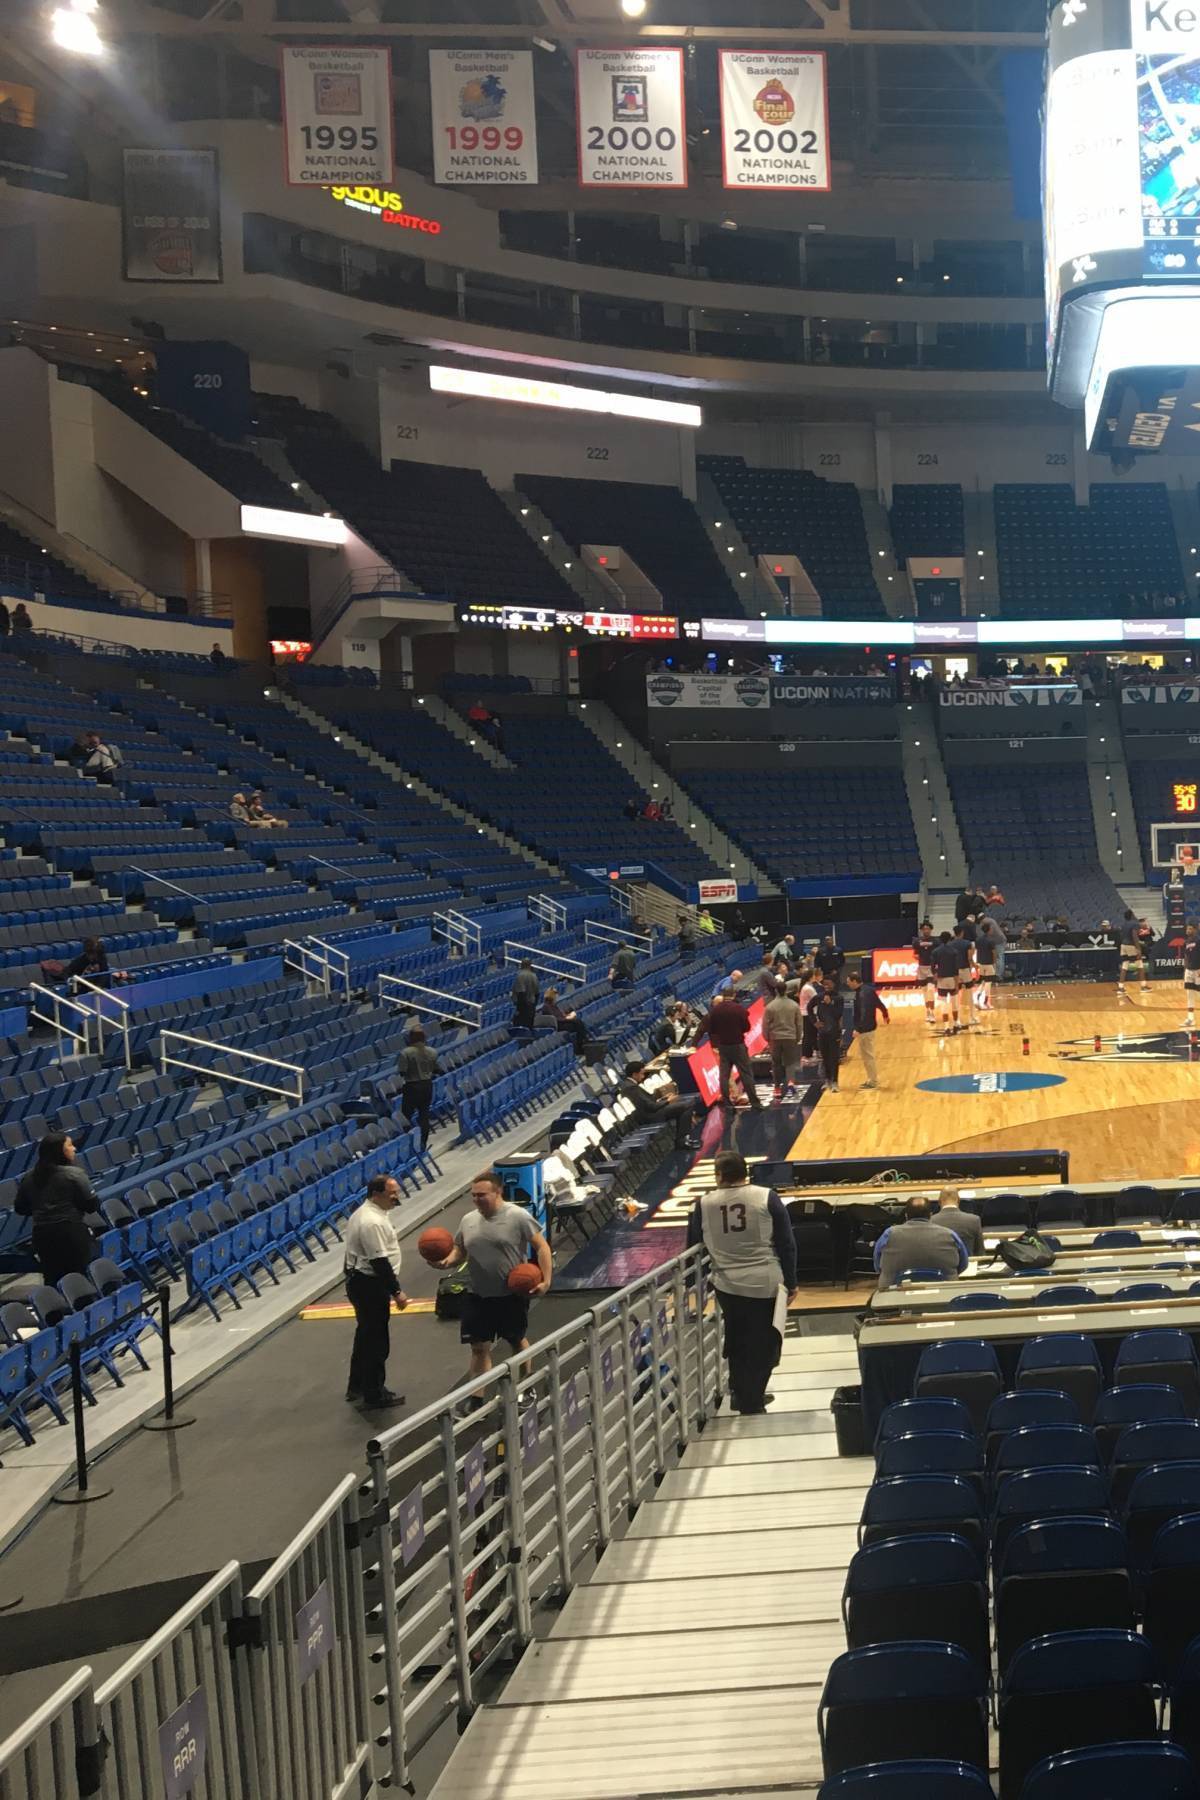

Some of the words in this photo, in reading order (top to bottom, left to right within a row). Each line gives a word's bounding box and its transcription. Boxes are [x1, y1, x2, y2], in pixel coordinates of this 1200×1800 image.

[731, 54, 765, 63] UConn
[768, 55, 814, 64] Women's
[454, 63, 509, 72] Basketball
[602, 63, 656, 73] Basketball
[746, 67, 800, 76] Basketball
[300, 125, 378, 150] 1995
[444, 126, 523, 150] 1999
[587, 126, 676, 151] 2000
[733, 129, 818, 154] 2002
[305, 156, 377, 167] NATIONAL
[450, 156, 520, 167] NATIONAL
[598, 156, 667, 167] NATIONAL
[742, 158, 811, 169] NATIONAL
[300, 170, 383, 181] CHAMPIONS
[445, 170, 527, 181] CHAMPIONS
[592, 170, 673, 181] CHAMPIONS
[737, 173, 817, 185] CHAMPIONS
[382, 208, 441, 235] DATTCO
[193, 374, 223, 388] 220
[396, 424, 419, 440] 221
[586, 447, 610, 460] 222
[819, 453, 841, 465] 223
[917, 453, 939, 465] 224
[1046, 453, 1067, 465] 225
[774, 685, 829, 700] UCONN
[939, 691, 1005, 707] UCONN
[778, 743, 796, 752] 120
[1008, 740, 1024, 748] 121
[1175, 794, 1196, 812] 30
[701, 885, 736, 898] ESPN
[719, 1202, 747, 1234] 13
[307, 1624, 323, 1656] PPP
[175, 1721, 190, 1742] ROW
[173, 1738, 197, 1778] RRR
